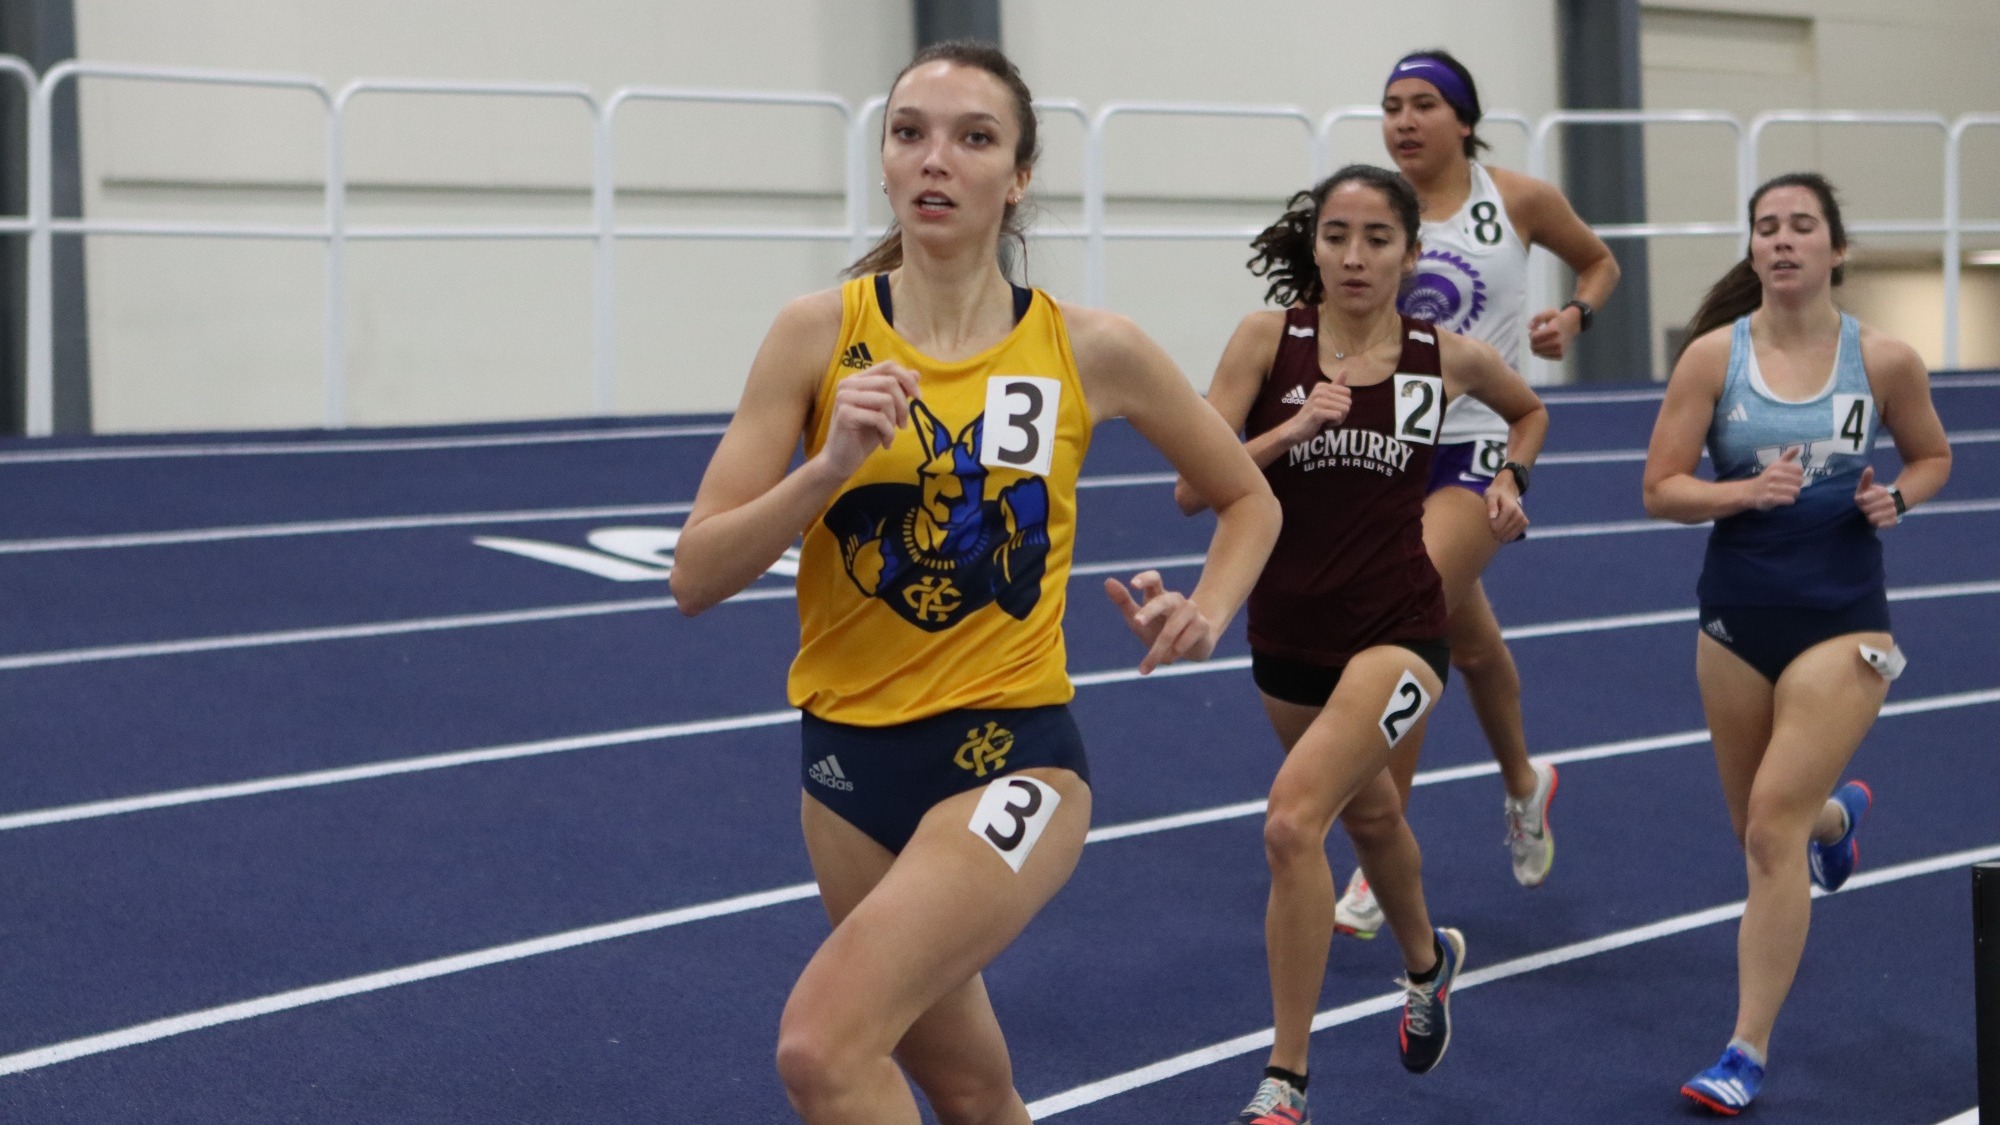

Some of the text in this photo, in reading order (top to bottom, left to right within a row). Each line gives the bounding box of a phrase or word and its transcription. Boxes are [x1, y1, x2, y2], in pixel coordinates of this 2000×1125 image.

[1471, 201, 1503, 246] 8
[997, 381, 1044, 465] 3
[1281, 396, 1306, 405] adida
[1401, 380, 1434, 440] 2
[1840, 399, 1865, 451] 4
[1303, 457, 1394, 477] WAR HAWKS
[1383, 682, 1422, 742] 2
[808, 767, 854, 792] adidas
[984, 779, 1043, 852] 3
